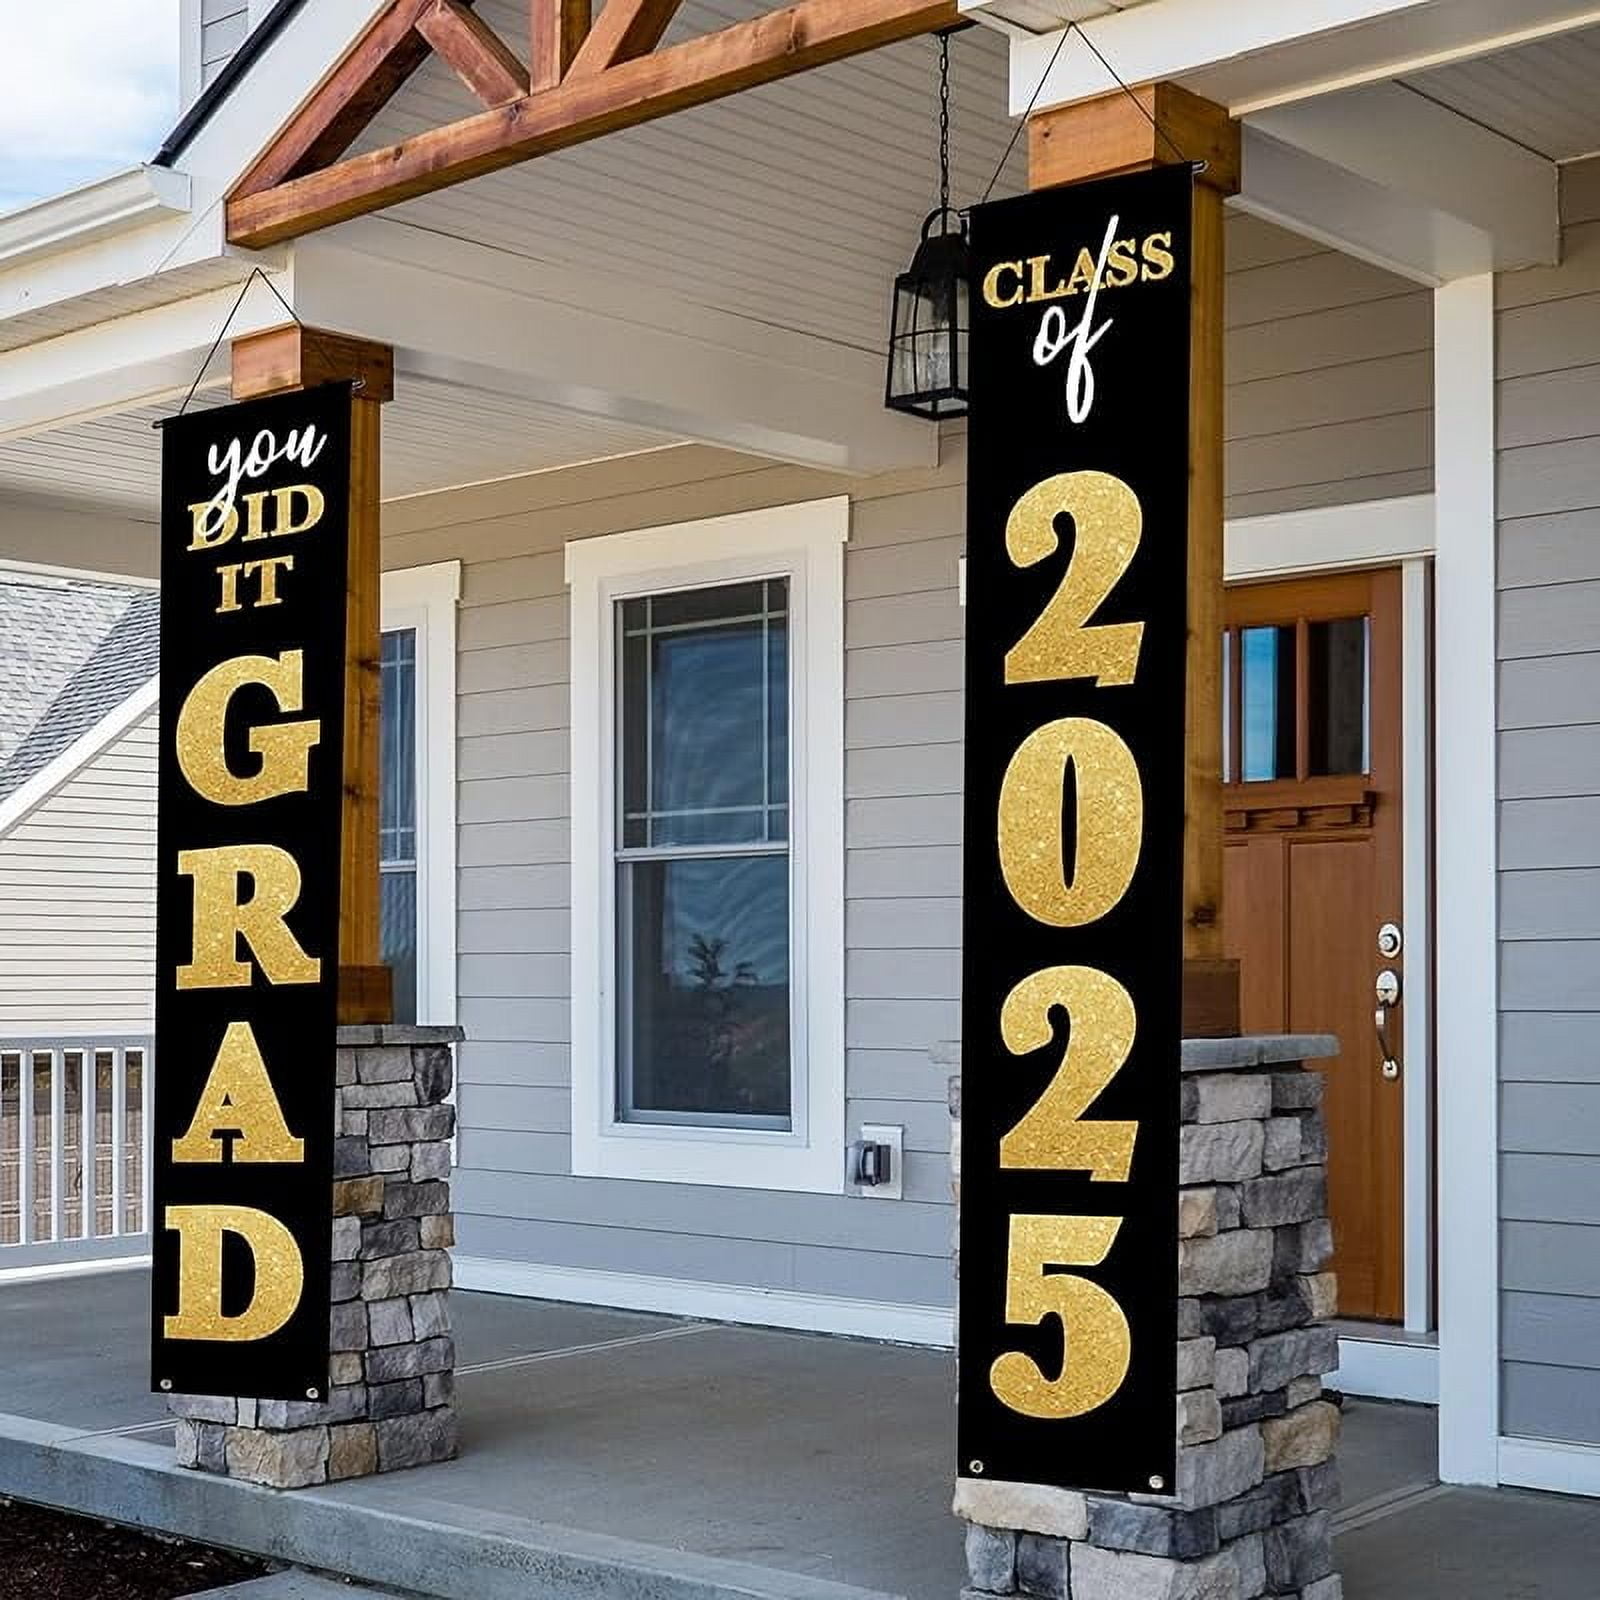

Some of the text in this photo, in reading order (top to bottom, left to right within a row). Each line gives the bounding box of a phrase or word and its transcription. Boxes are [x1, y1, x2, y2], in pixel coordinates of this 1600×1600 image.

[983, 231, 1174, 308] CLASS
[1033, 215, 1113, 423] of
[187, 484, 325, 551] DID
[197, 424, 328, 537] you
[215, 555, 294, 613] IT
[165, 649, 322, 1341] GRAD
[990, 470, 1145, 1419] 2025
